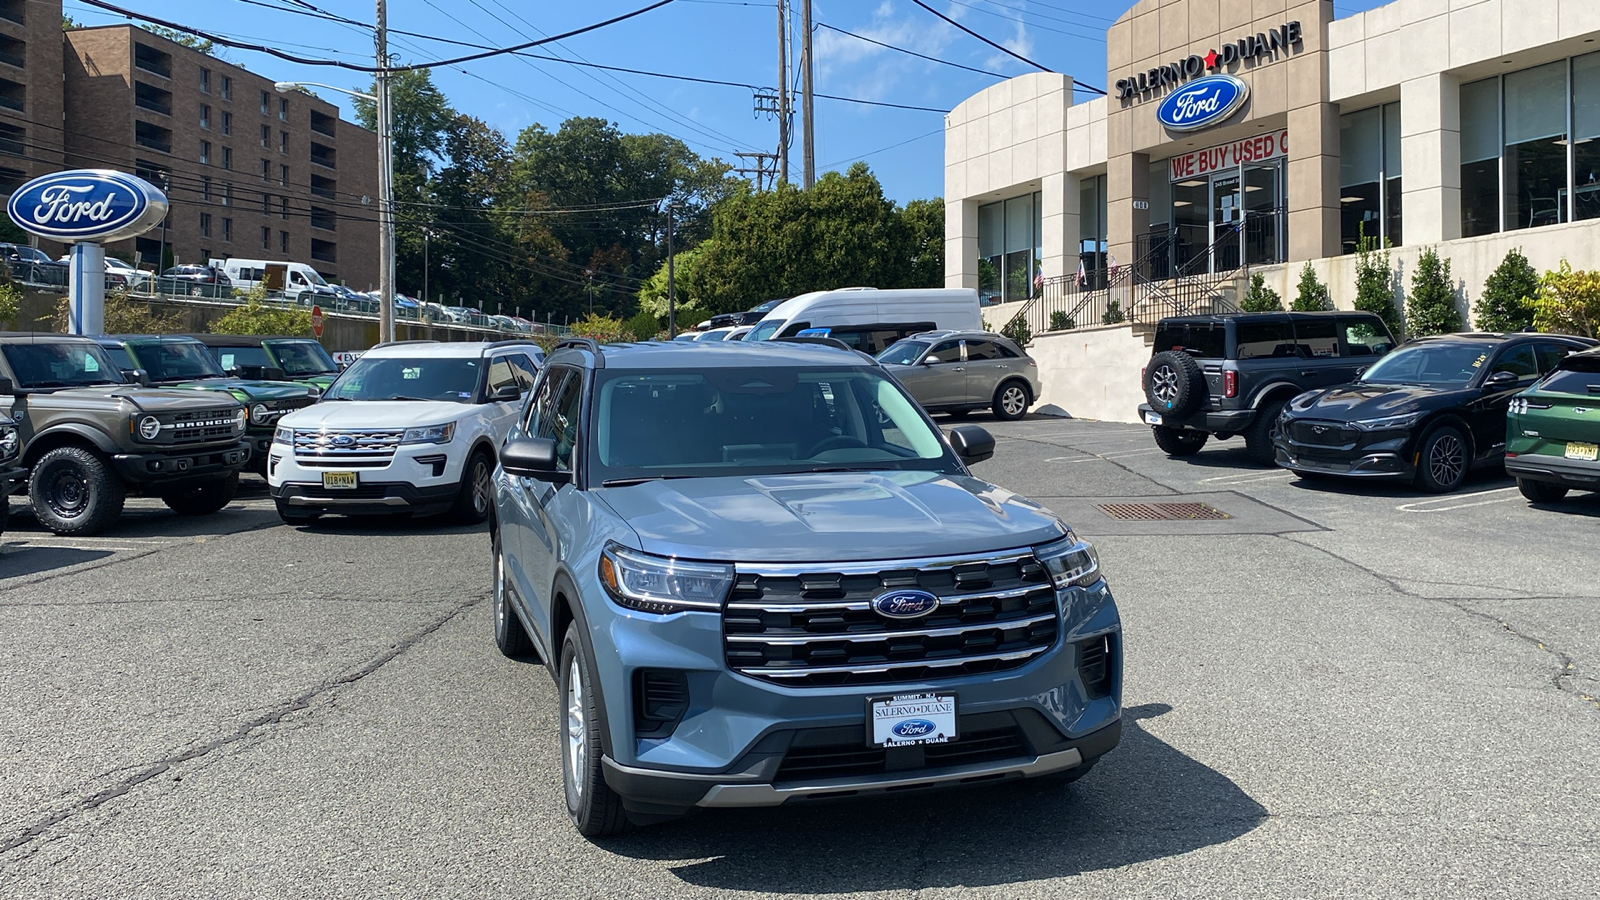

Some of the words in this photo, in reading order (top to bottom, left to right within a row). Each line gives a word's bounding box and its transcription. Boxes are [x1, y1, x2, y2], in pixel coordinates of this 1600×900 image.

[1115, 55, 1204, 100] SALERNO
[1221, 21, 1302, 65] DUANE
[1172, 87, 1221, 122] Ford
[1172, 154, 1195, 178] WE
[1199, 146, 1228, 173] BUY
[1232, 135, 1275, 164] USED
[33, 184, 116, 224] Ford
[344, 353, 361, 362] EXI
[176, 419, 231, 428] BRONCO
[890, 595, 925, 612] Ford
[875, 705, 916, 718] SALERNO
[920, 703, 953, 714] DUANE
[900, 722, 928, 735] Ford
[882, 740, 916, 748] SALERNO
[925, 737, 949, 745] DUANE
